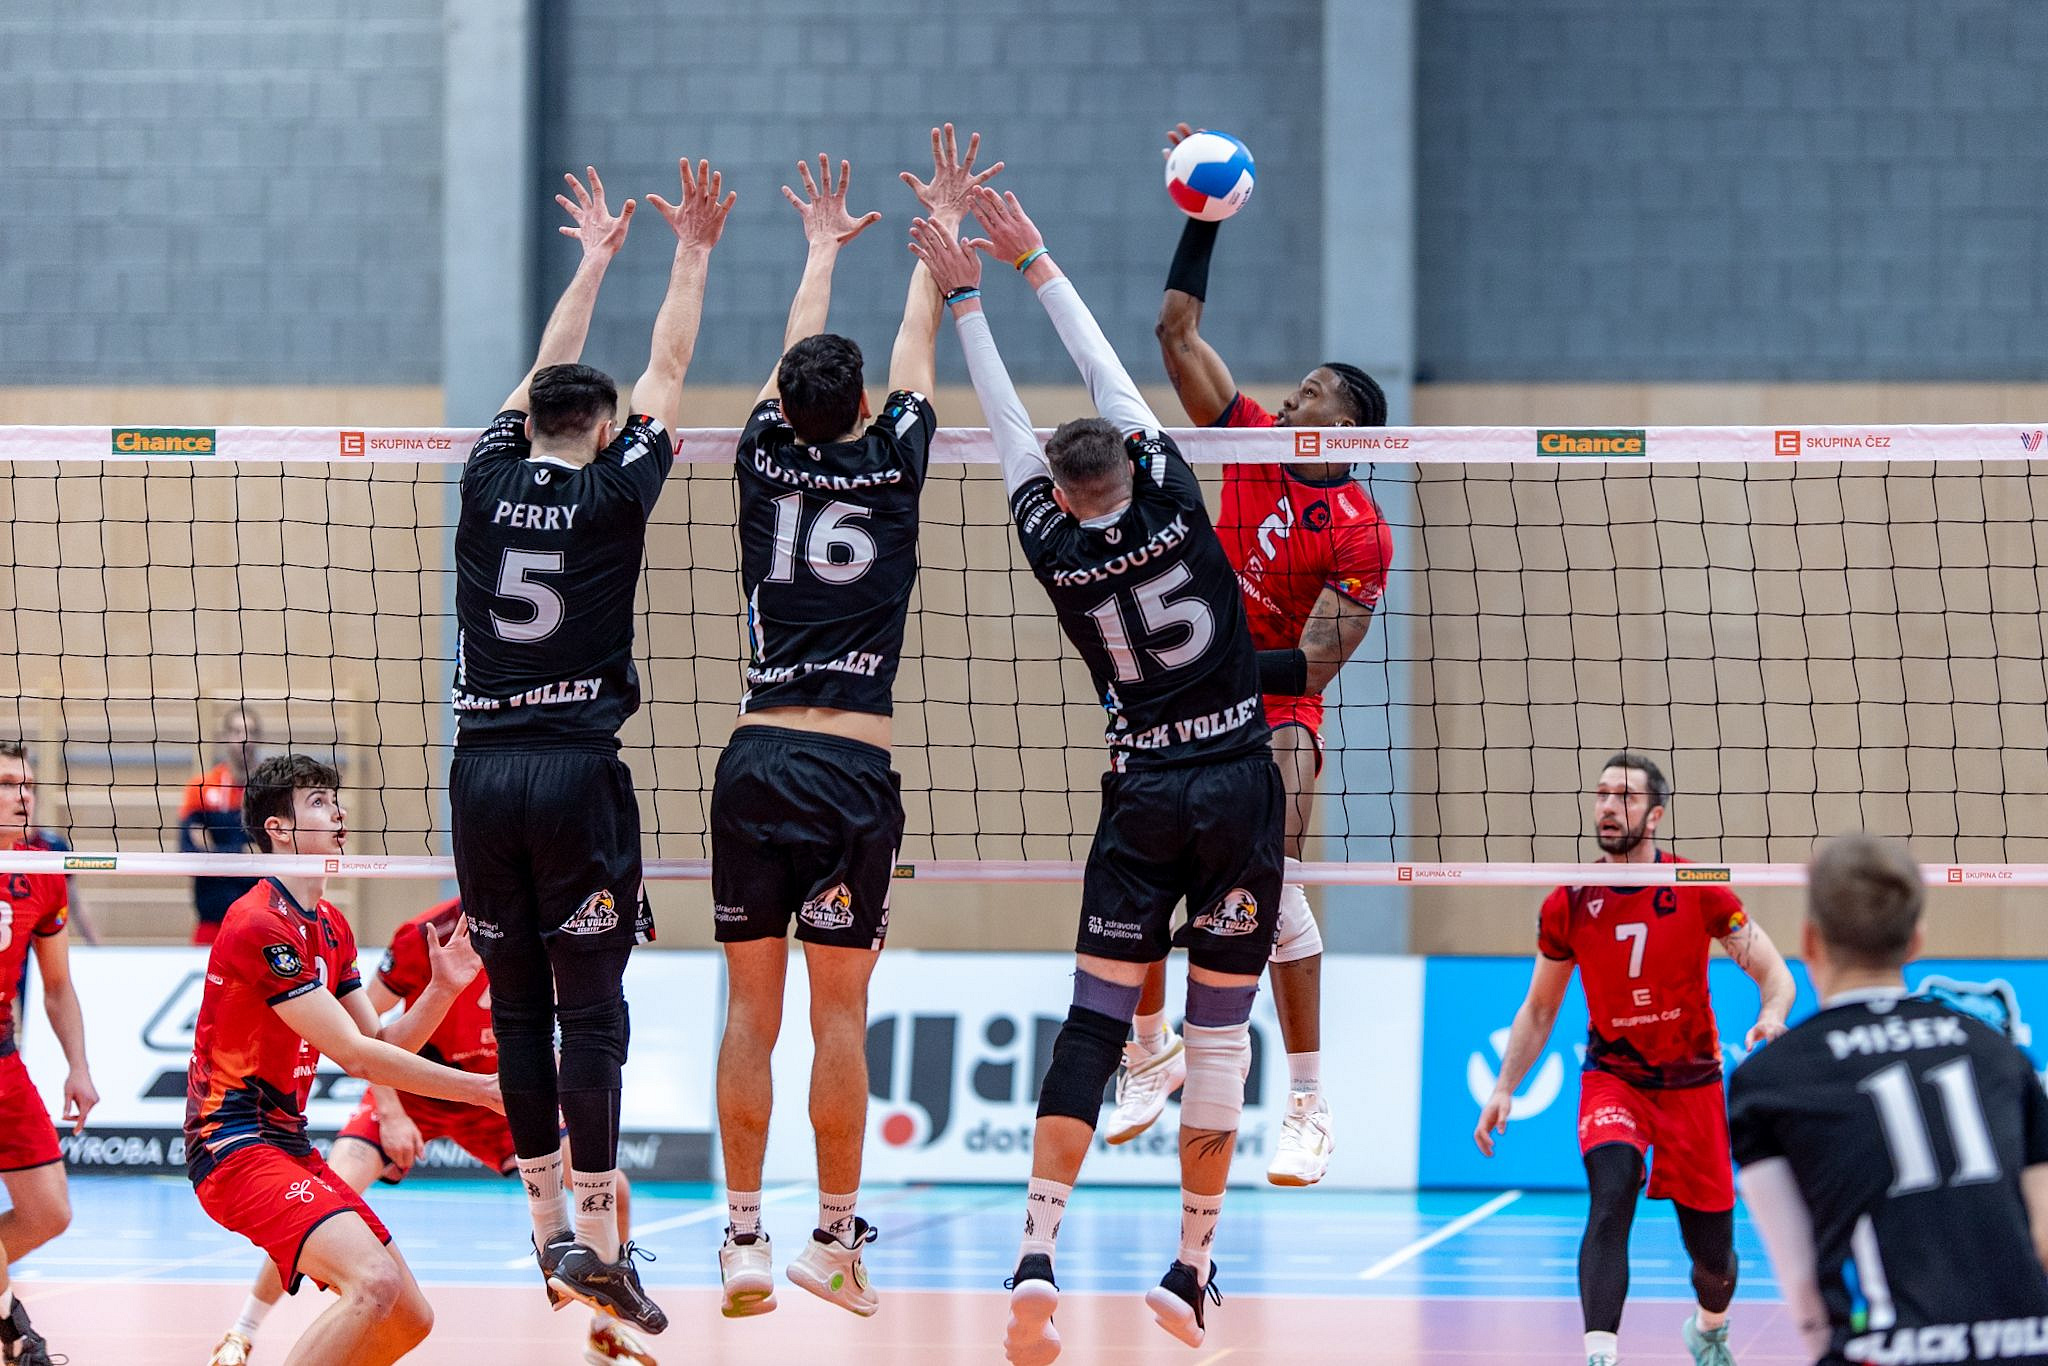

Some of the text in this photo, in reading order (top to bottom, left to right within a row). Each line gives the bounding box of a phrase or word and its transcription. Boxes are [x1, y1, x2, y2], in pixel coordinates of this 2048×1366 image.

[116, 432, 211, 452] Chance
[370, 435, 451, 450] SKUPINA ČEZ
[1326, 435, 1409, 450] SKUPINA ČEZ
[1541, 433, 1641, 454] Chance
[1806, 434, 1890, 449] SKUPINA ČEZ
[490, 500, 580, 530] PERRY
[763, 490, 878, 585] 16
[1053, 513, 1190, 587] KOLOUSEK
[489, 547, 565, 644] 5
[1085, 560, 1216, 685] 15
[509, 677, 602, 707] VOLLEY
[66, 858, 115, 870] Chance
[1677, 869, 1728, 881] Chance
[1615, 922, 1648, 978] 7
[1826, 1015, 1969, 1060] MIŠEK
[1855, 1054, 2004, 1199] 11
